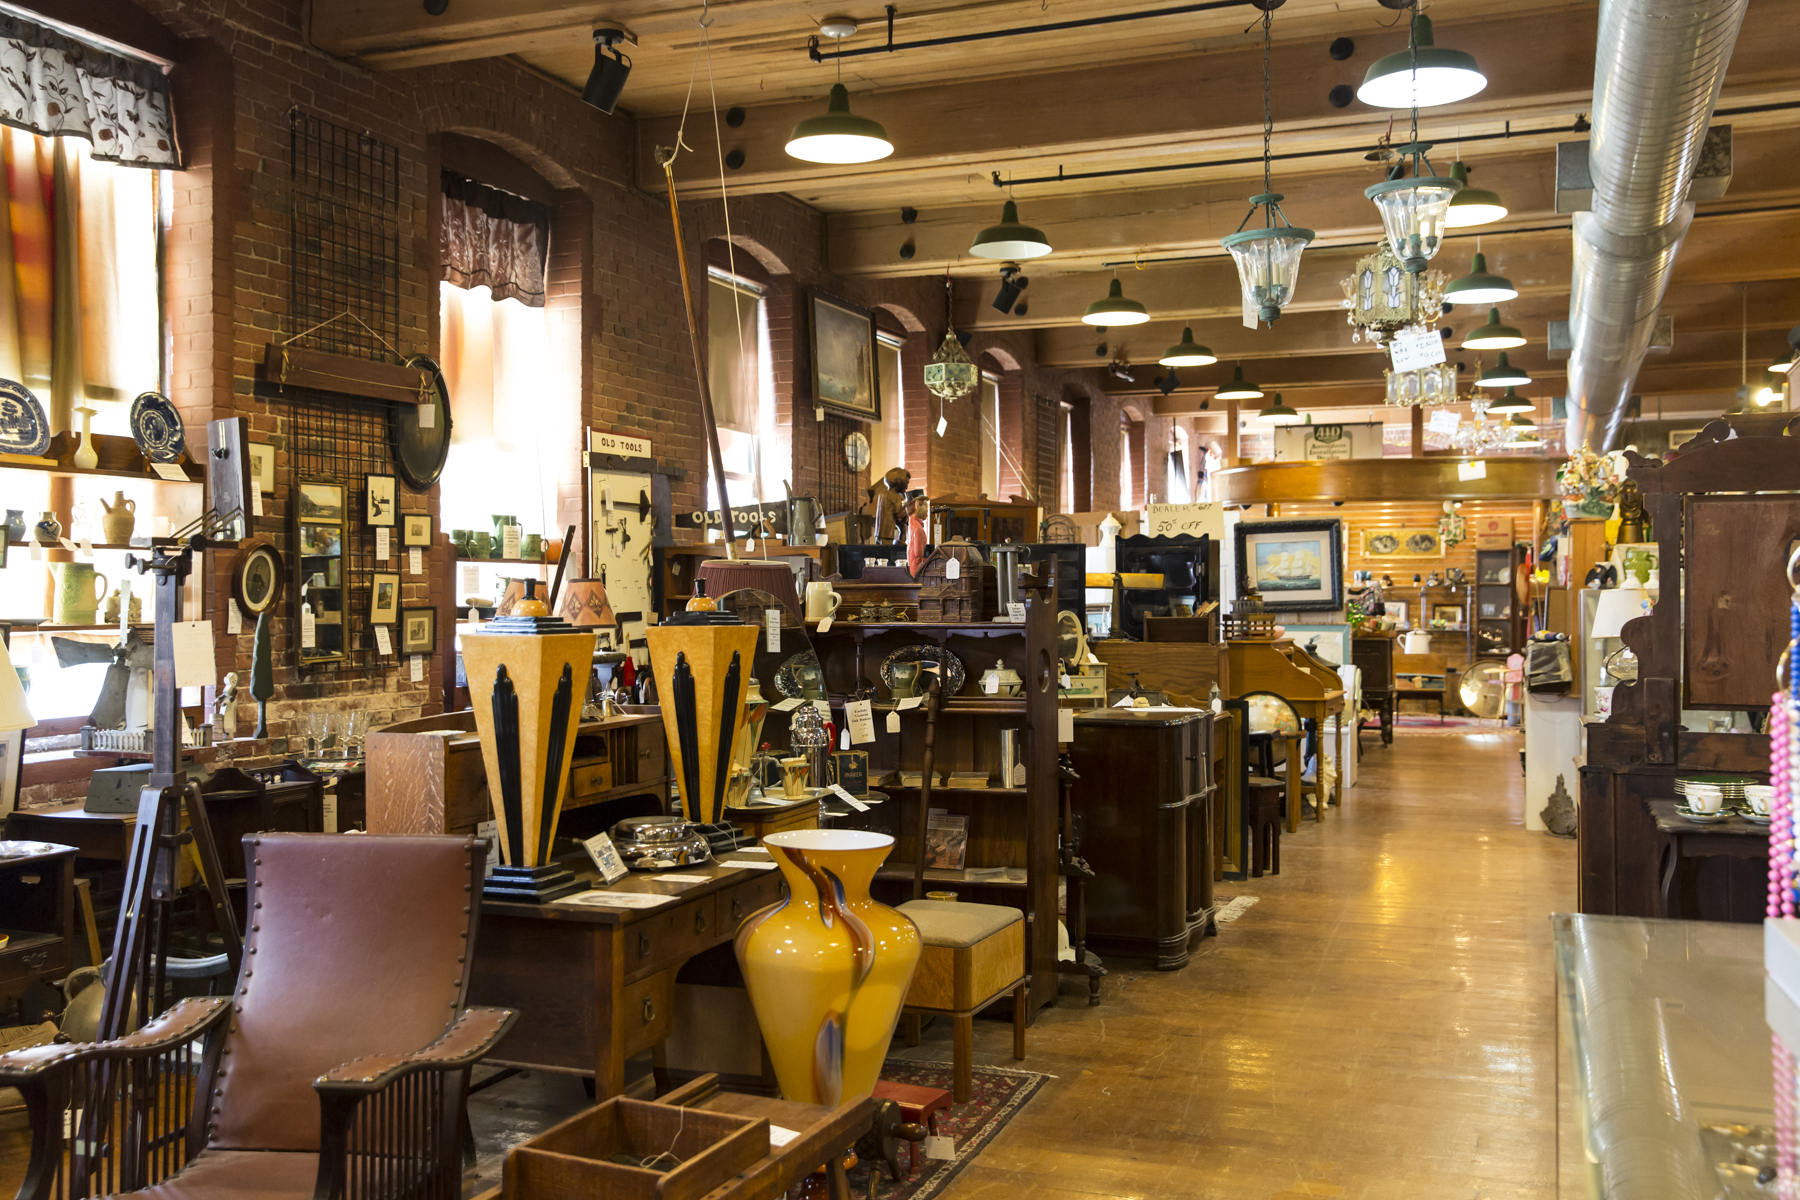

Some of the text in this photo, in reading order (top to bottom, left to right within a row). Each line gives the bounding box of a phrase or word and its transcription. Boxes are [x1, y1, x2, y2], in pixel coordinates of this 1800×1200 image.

[601, 437, 643, 453] OLD TOOLS
[1152, 504, 1191, 514] DEALER
[691, 510, 723, 525] OLD
[1181, 520, 1203, 531] OFF
